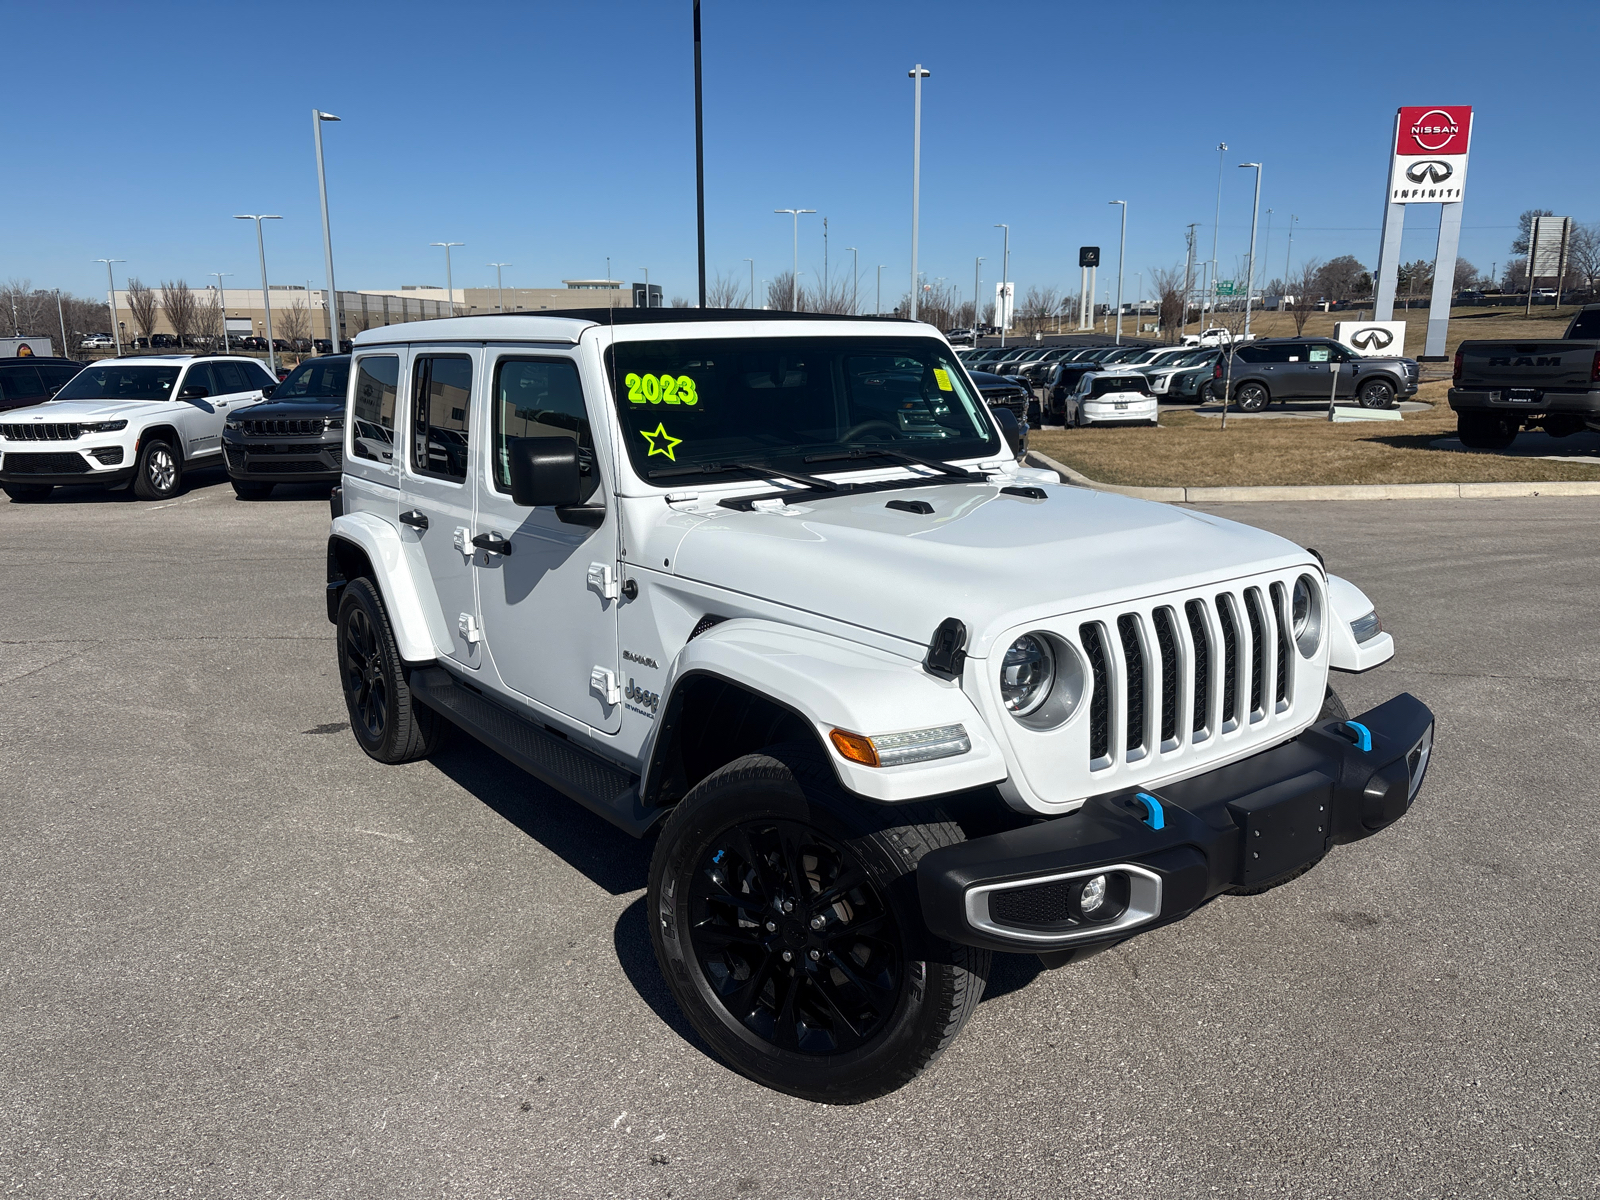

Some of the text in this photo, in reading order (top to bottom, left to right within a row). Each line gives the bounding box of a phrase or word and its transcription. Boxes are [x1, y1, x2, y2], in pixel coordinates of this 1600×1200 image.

[1411, 126, 1459, 134] NISSAN
[1394, 189, 1461, 198] INFINITI
[1488, 357, 1562, 367] RAM
[625, 372, 698, 406] 2023
[622, 650, 660, 670] SAHARA
[625, 677, 660, 714] Jeep
